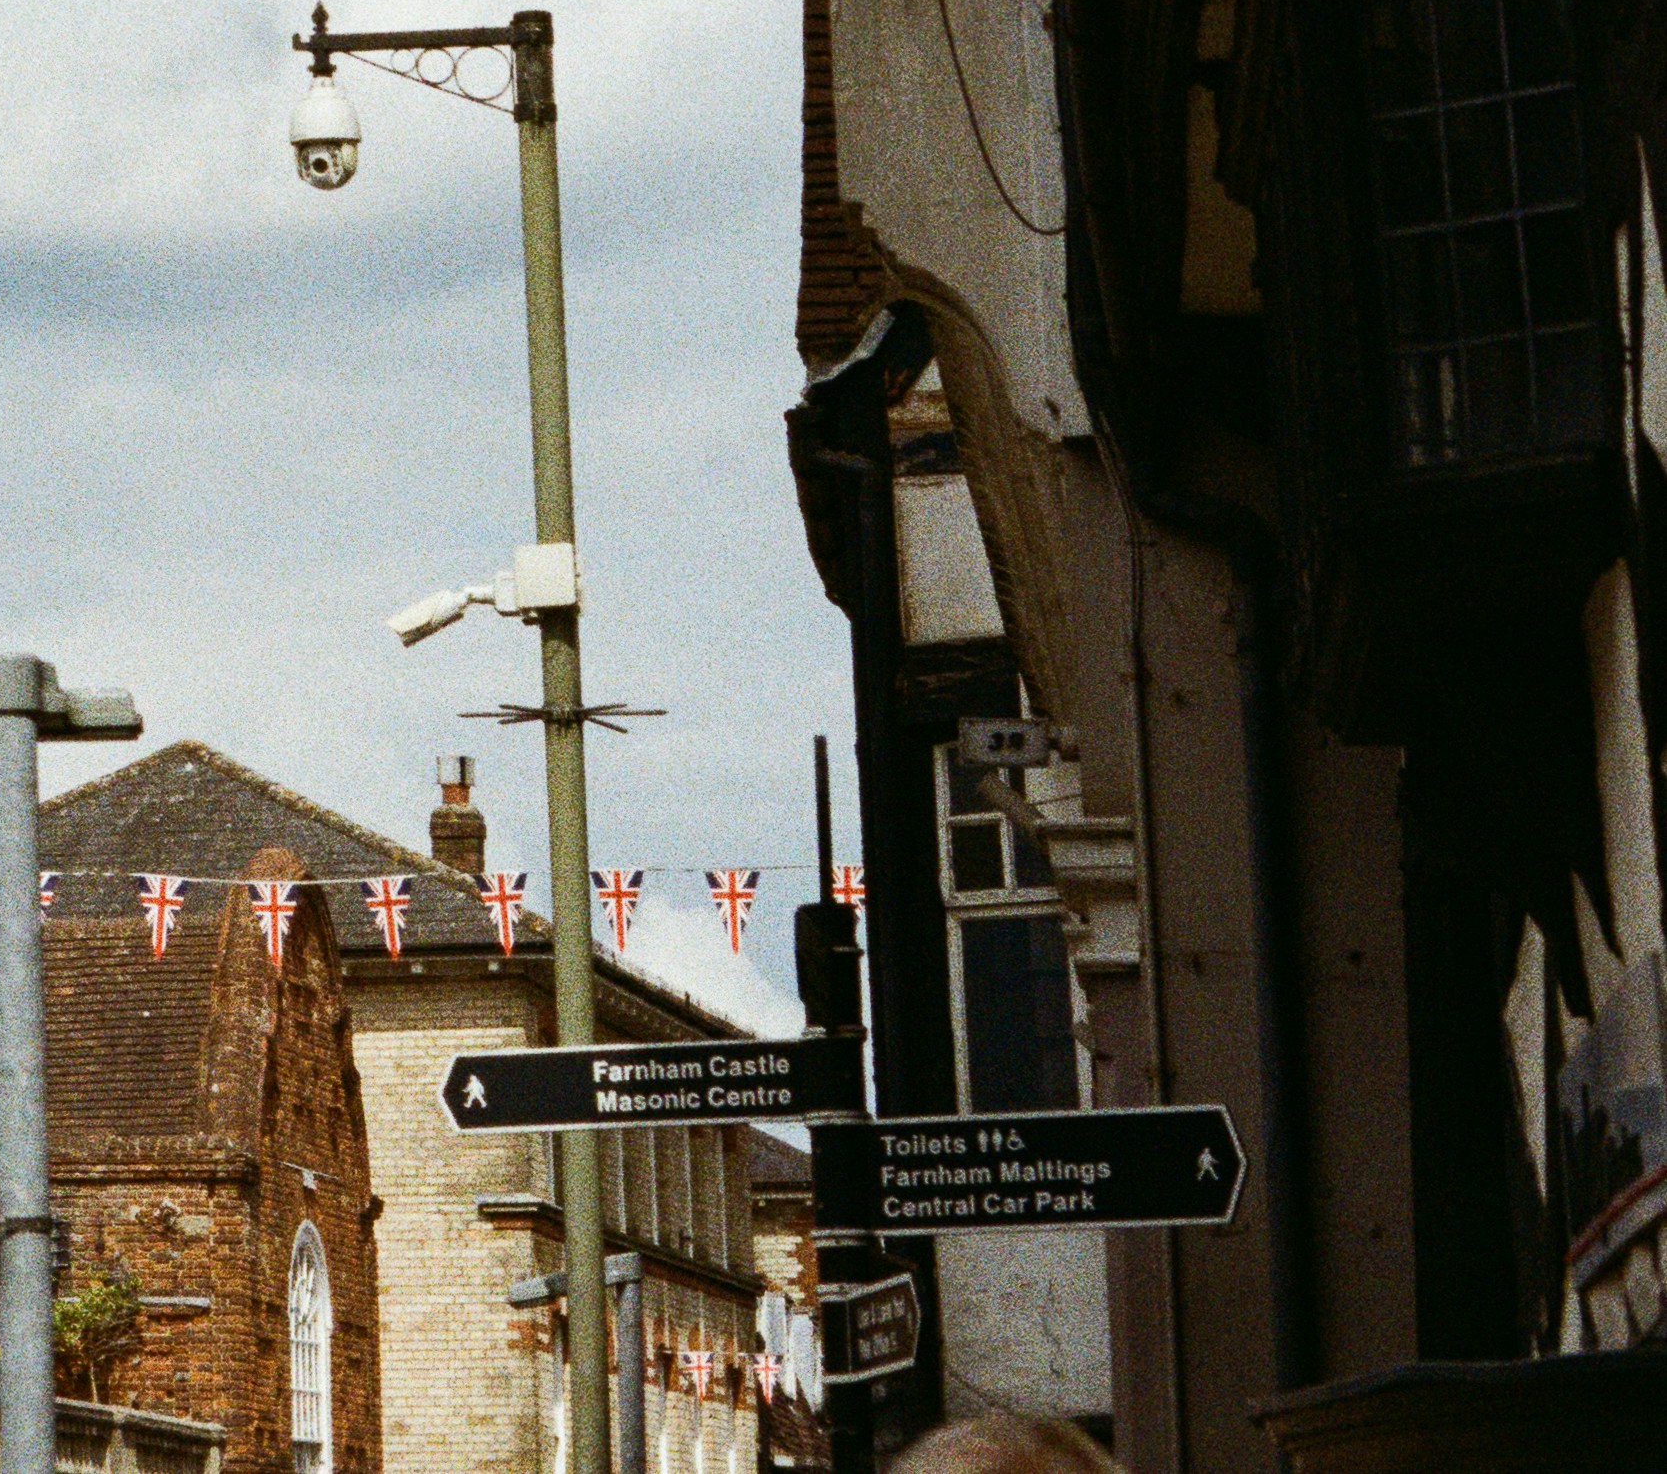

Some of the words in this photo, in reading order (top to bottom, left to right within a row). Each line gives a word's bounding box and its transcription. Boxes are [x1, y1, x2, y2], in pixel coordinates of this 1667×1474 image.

[592, 1059, 703, 1083] Farnham
[709, 1054, 790, 1077] Castle
[596, 1088, 701, 1112] Masonic
[707, 1086, 792, 1108] Centre
[880, 1134, 968, 1156] Toilets
[880, 1164, 993, 1187] Farnham
[999, 1160, 1112, 1185] Maltings
[883, 1194, 976, 1218] Central
[982, 1193, 1028, 1214] Car
[1035, 1190, 1096, 1213] Park
